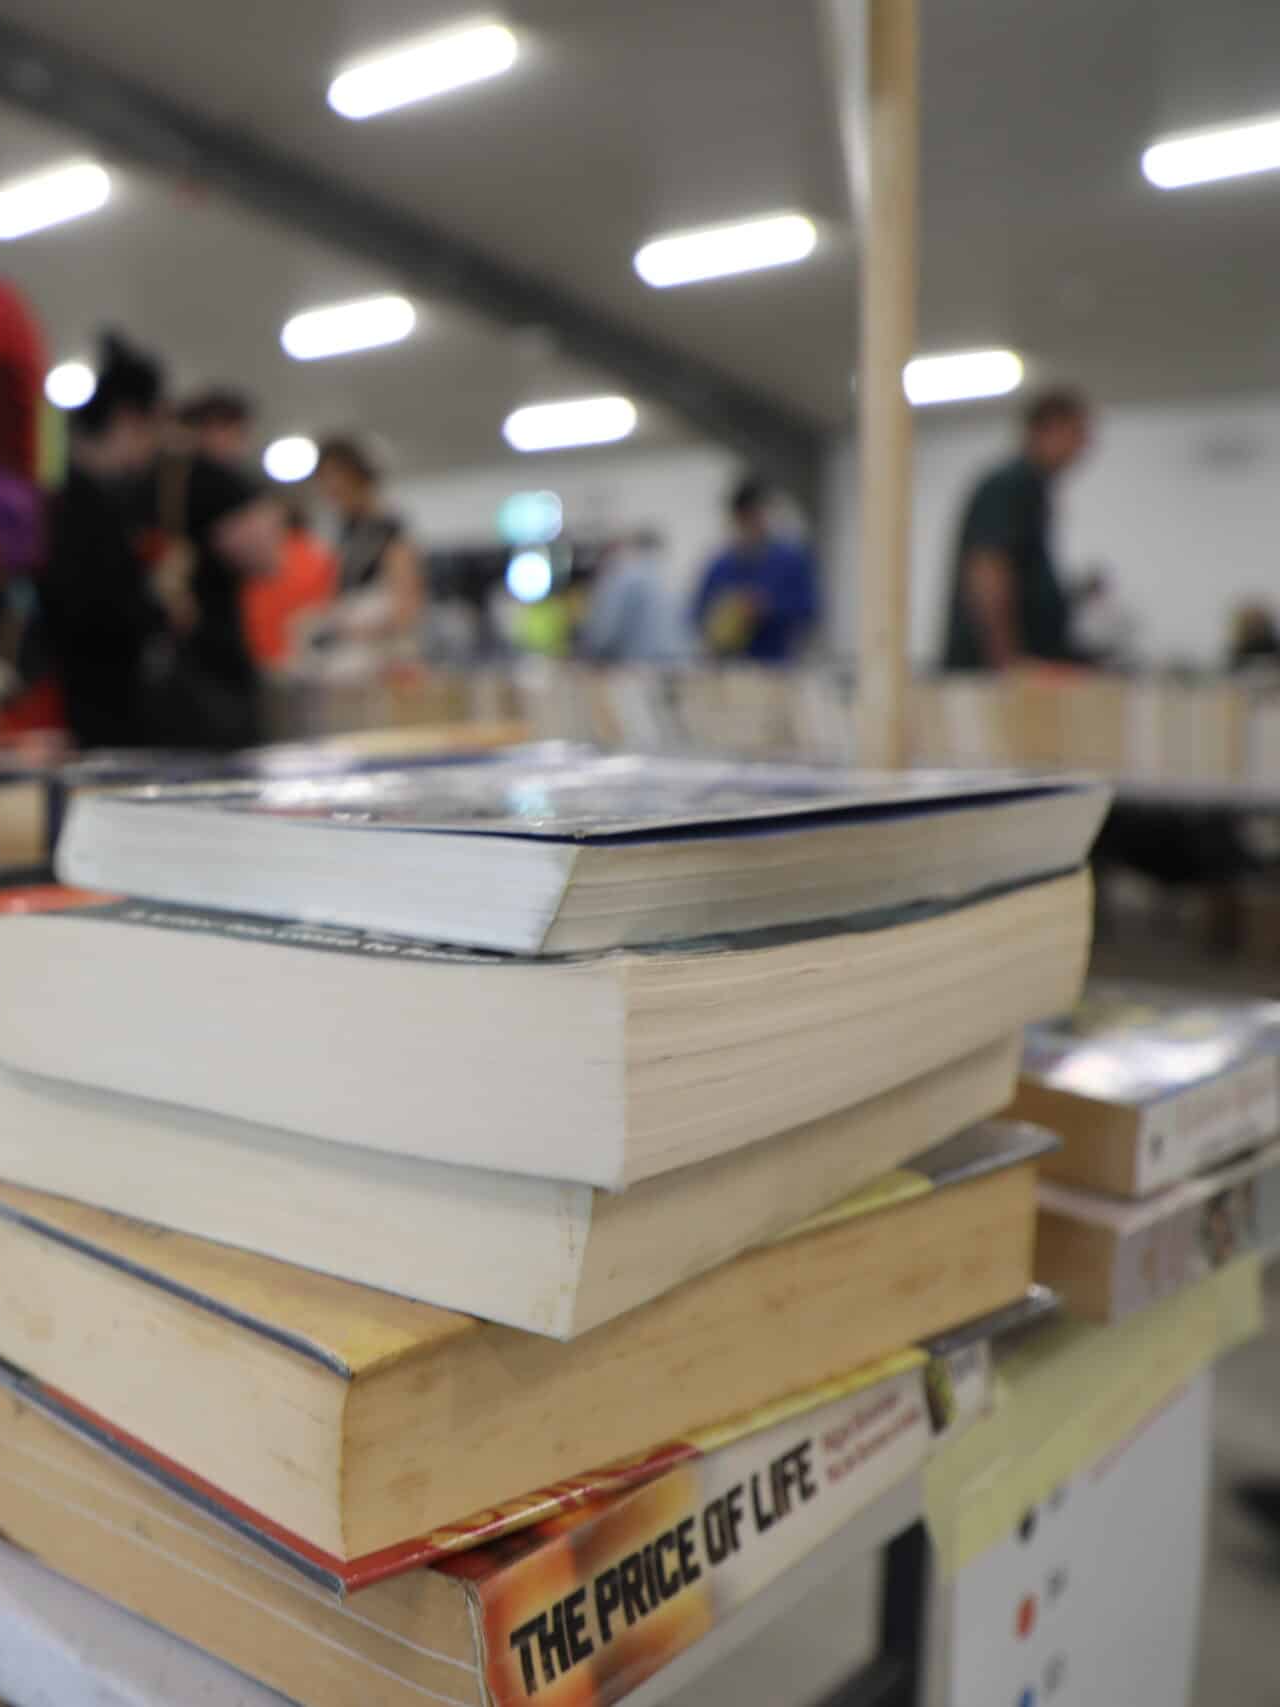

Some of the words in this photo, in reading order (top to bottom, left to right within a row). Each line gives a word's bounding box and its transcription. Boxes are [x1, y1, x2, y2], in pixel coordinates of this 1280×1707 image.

[509, 1599, 594, 1697] THE
[594, 1517, 702, 1640] PRICE
[701, 1485, 748, 1567] OF
[750, 1437, 817, 1535] LIFE
